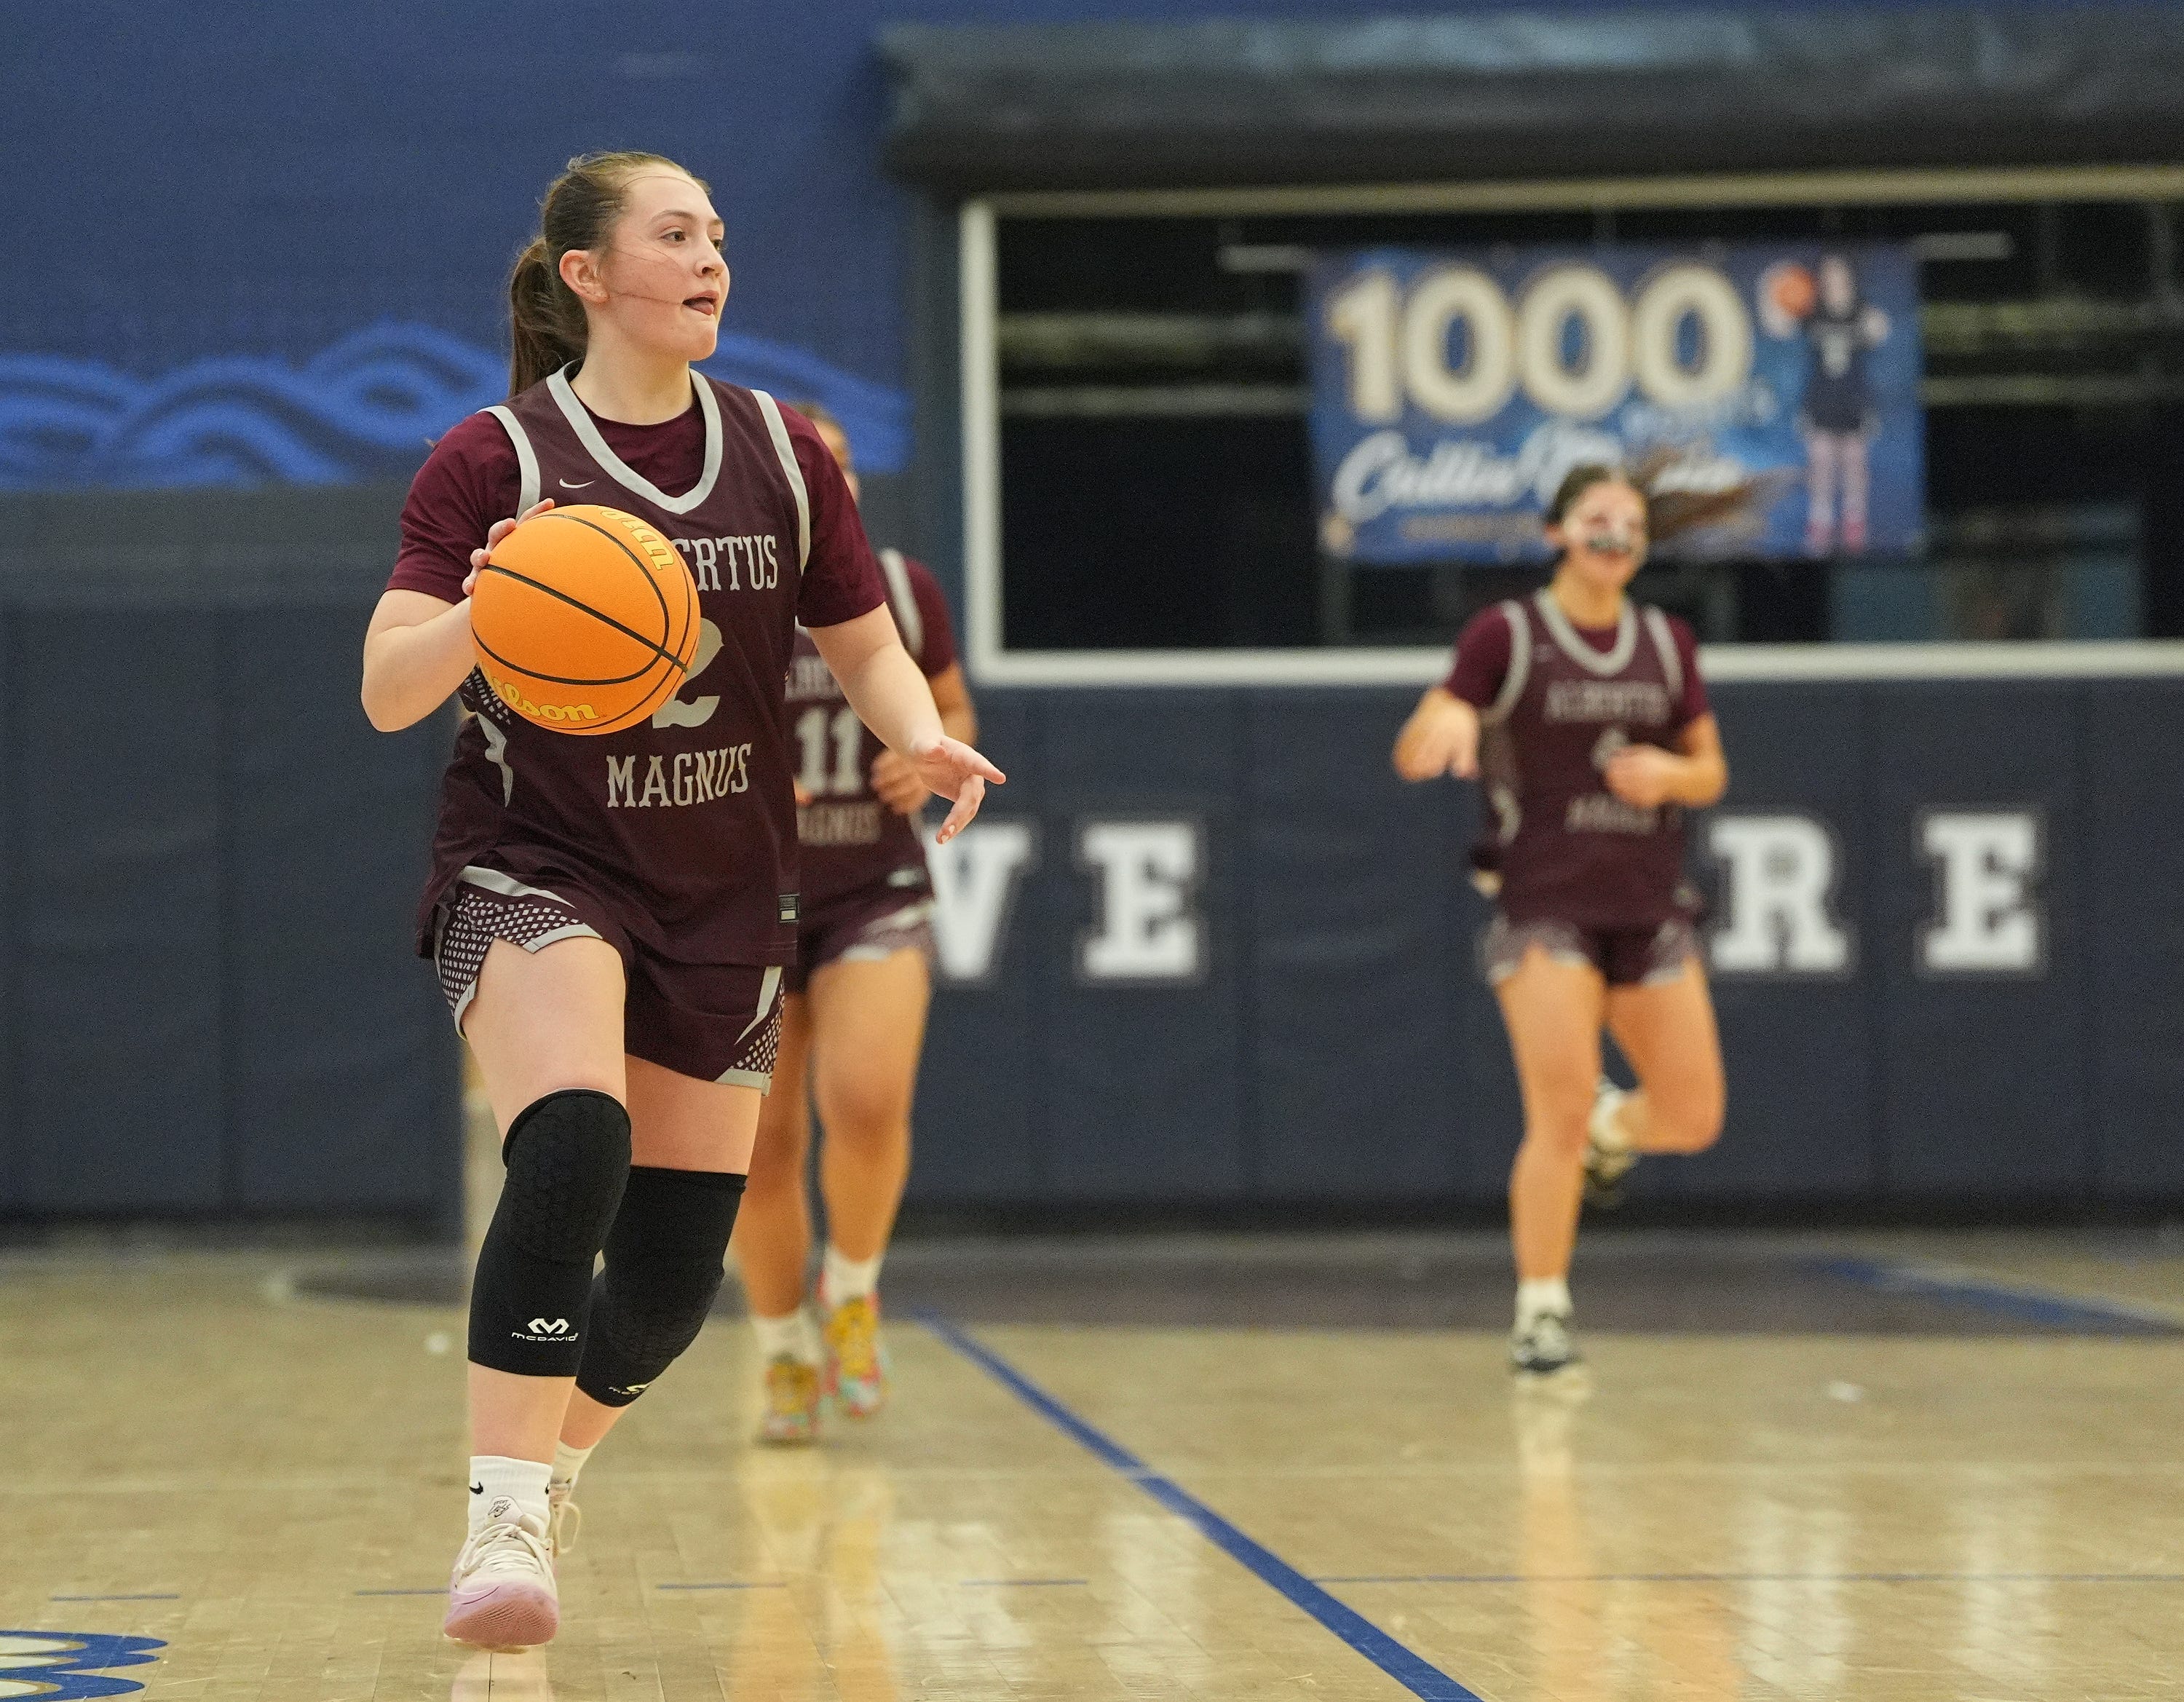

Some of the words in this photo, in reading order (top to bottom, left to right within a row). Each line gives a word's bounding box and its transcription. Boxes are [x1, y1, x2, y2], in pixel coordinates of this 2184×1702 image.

[1329, 264, 1752, 422] 1000
[478, 658, 600, 722] ilson
[606, 743, 752, 808] MAGNUS
[795, 705, 863, 795] 11
